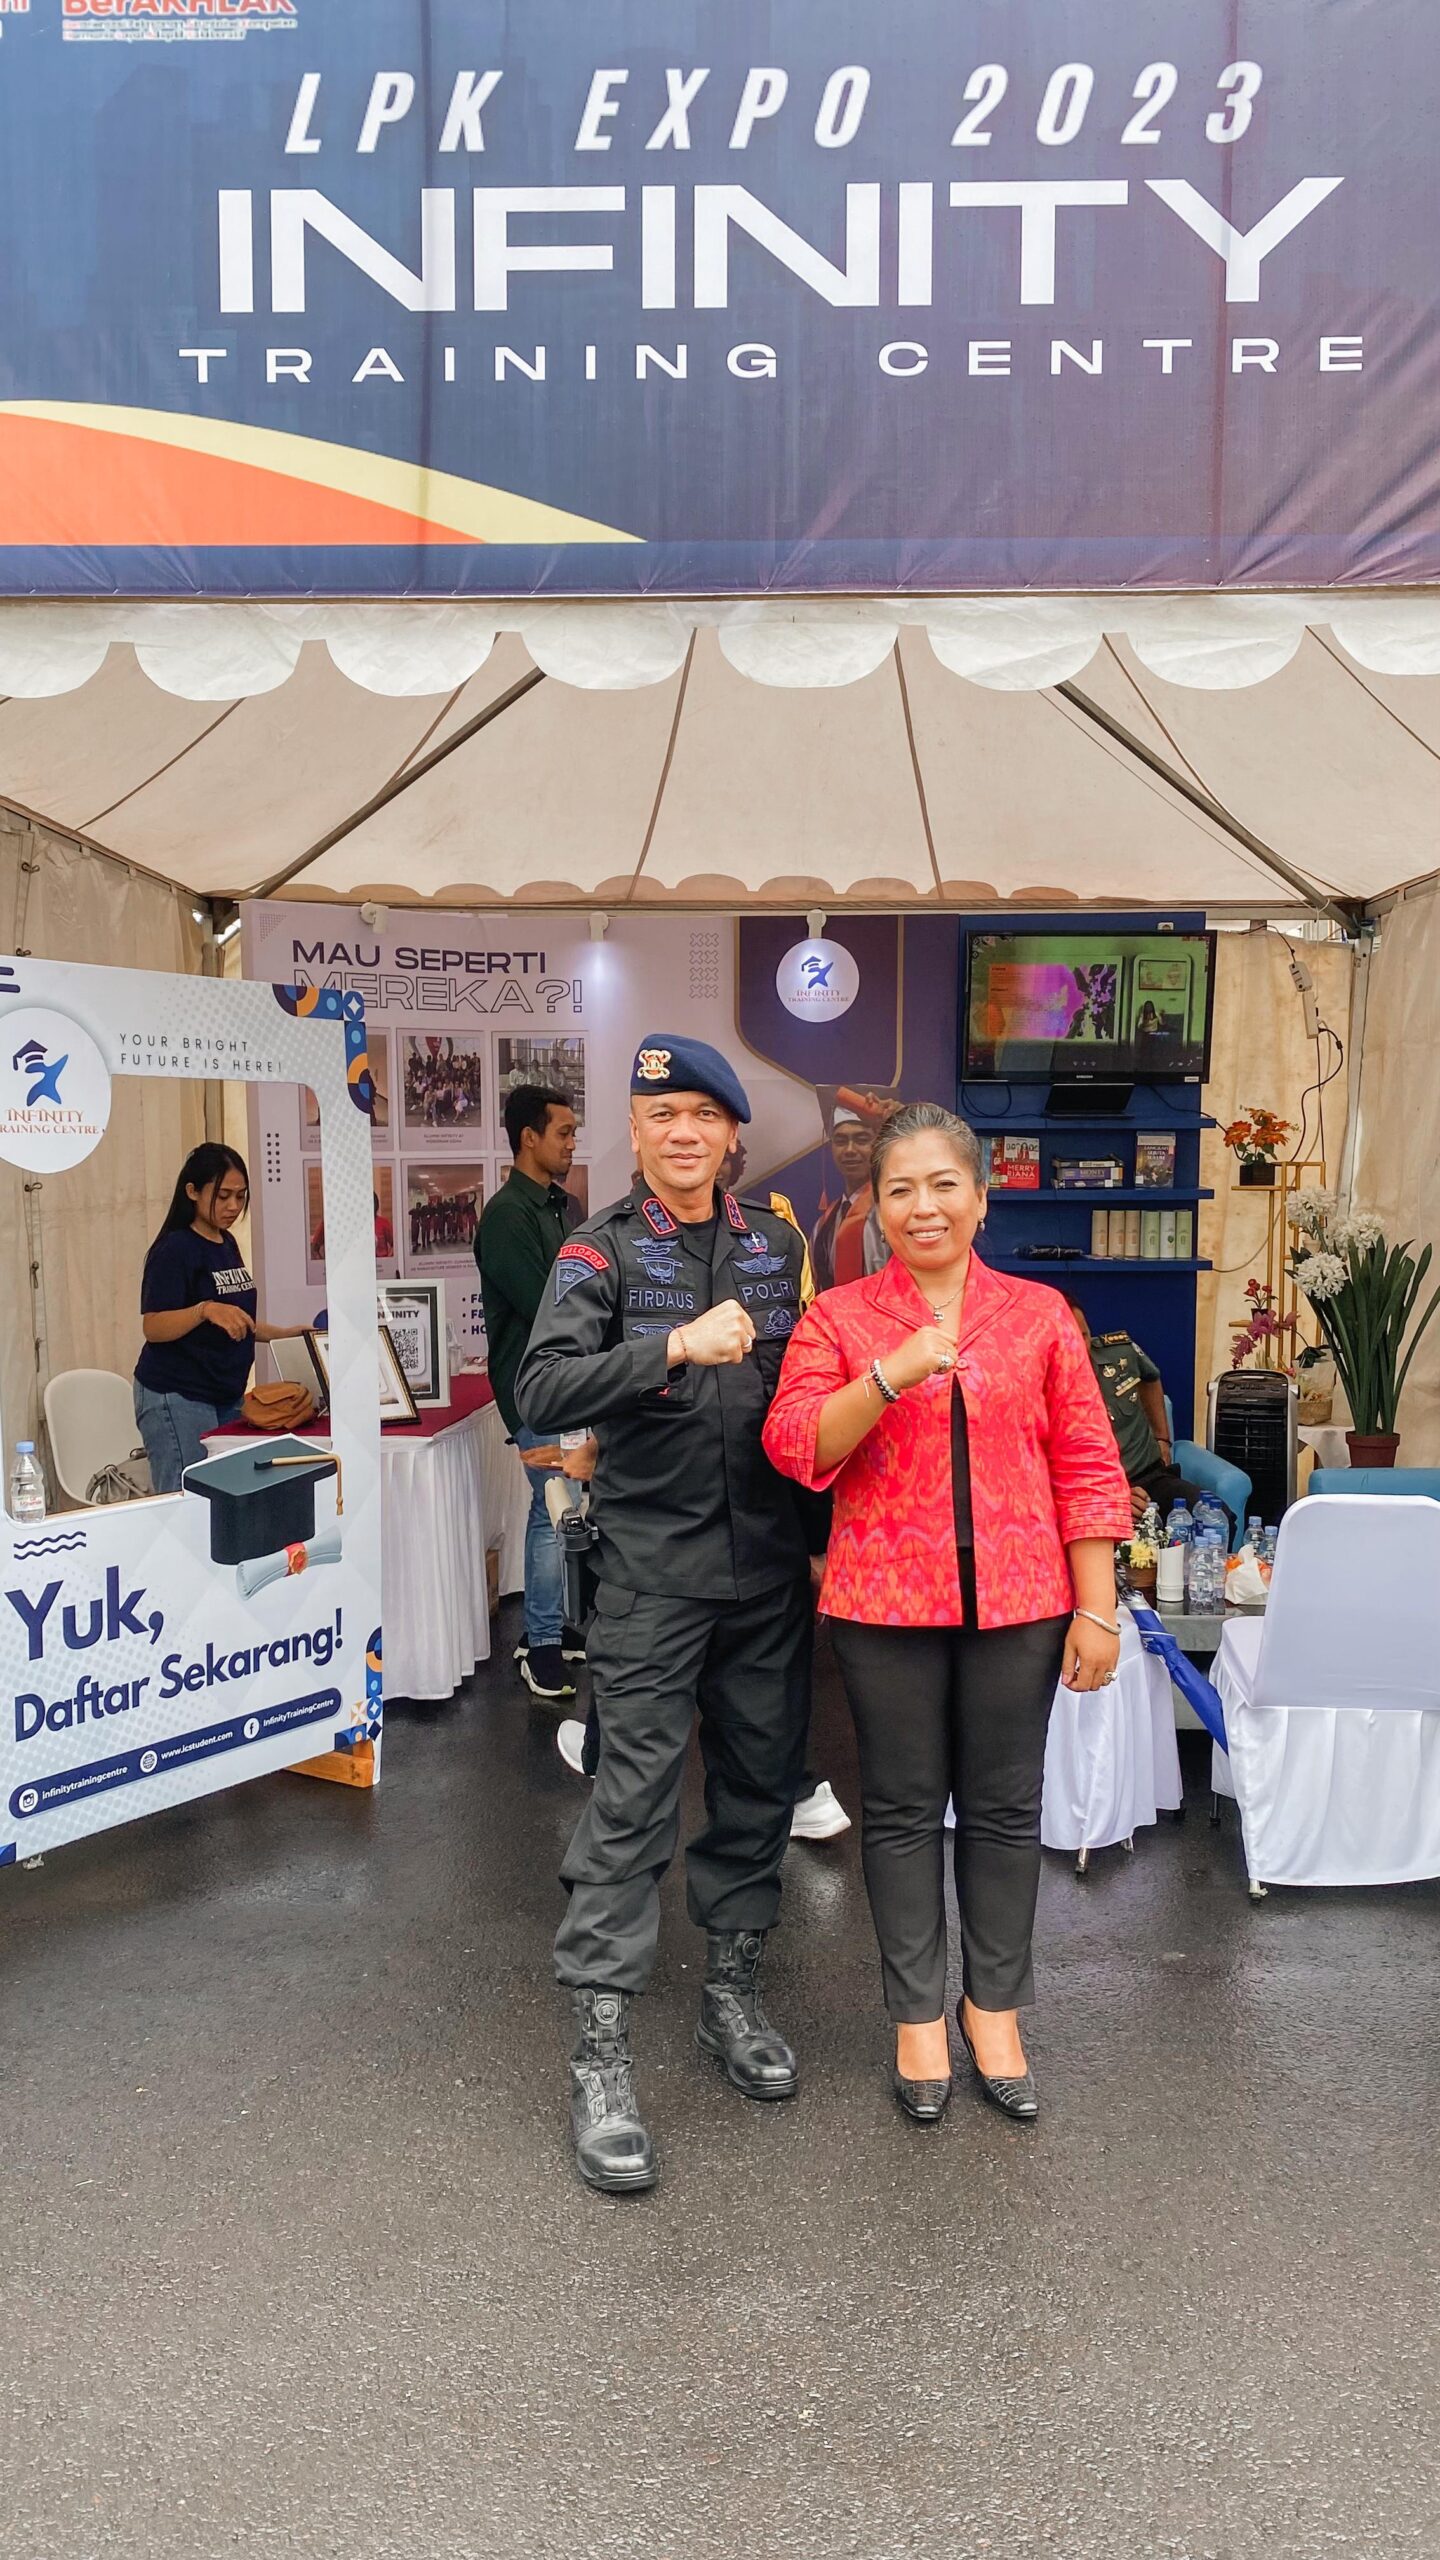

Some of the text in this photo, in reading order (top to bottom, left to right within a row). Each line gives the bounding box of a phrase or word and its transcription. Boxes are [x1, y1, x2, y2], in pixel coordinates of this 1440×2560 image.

[284, 60, 1264, 154] LPK EXPO 2023
[217, 176, 1346, 314] INFINITY
[178, 335, 1363, 385] TRAINING CENTRE
[292, 940, 546, 974] MAU SEPERTI
[119, 1033, 248, 1052] YOUR BRIGHT
[120, 1053, 283, 1073] FUTURE IS HERE!
[0, 1123, 99, 1135] RAINING CENTRE
[7, 1109, 84, 1124] INFINITY
[628, 1281, 795, 1310] FIRDAUS POLRI
[5, 1565, 165, 1661] Yuk,
[14, 1607, 344, 1742] Daftar Sekarang!
[42, 1766, 128, 1800] infinitytrainingcentre
[262, 1698, 335, 1728] InfinityTrainingCentre
